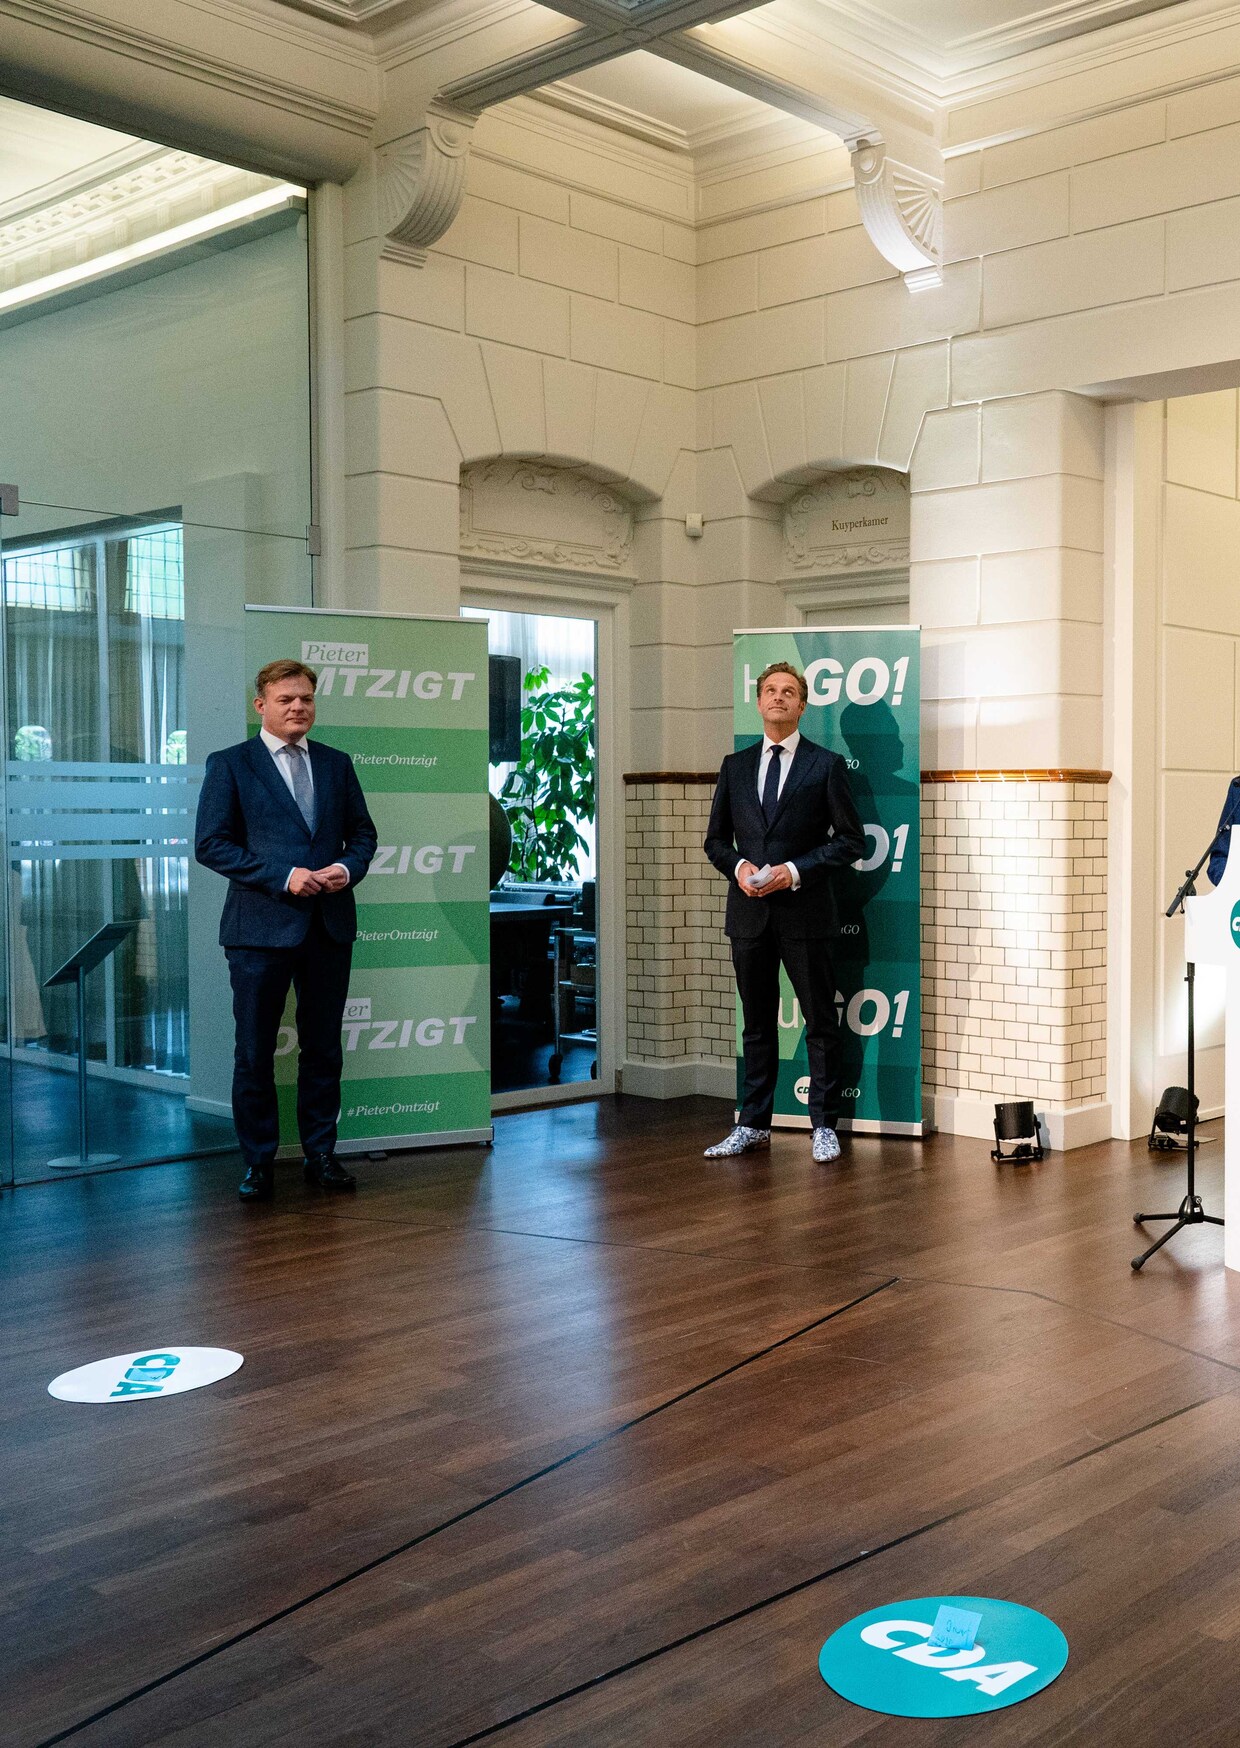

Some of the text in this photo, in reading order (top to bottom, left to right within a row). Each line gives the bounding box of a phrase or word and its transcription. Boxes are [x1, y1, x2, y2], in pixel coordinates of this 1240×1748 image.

[832, 516, 889, 532] Kuyperkamer
[304, 643, 366, 662] Pieter
[743, 656, 910, 706] HGO!
[353, 753, 438, 768] PieterOmtzigt
[368, 845, 476, 875] ZIGT
[356, 928, 439, 942] PieterOmtzigt
[797, 1086, 809, 1094] CD
[347, 1101, 440, 1118] #PieterOmtzigt
[860, 1619, 1039, 1697] CDA
